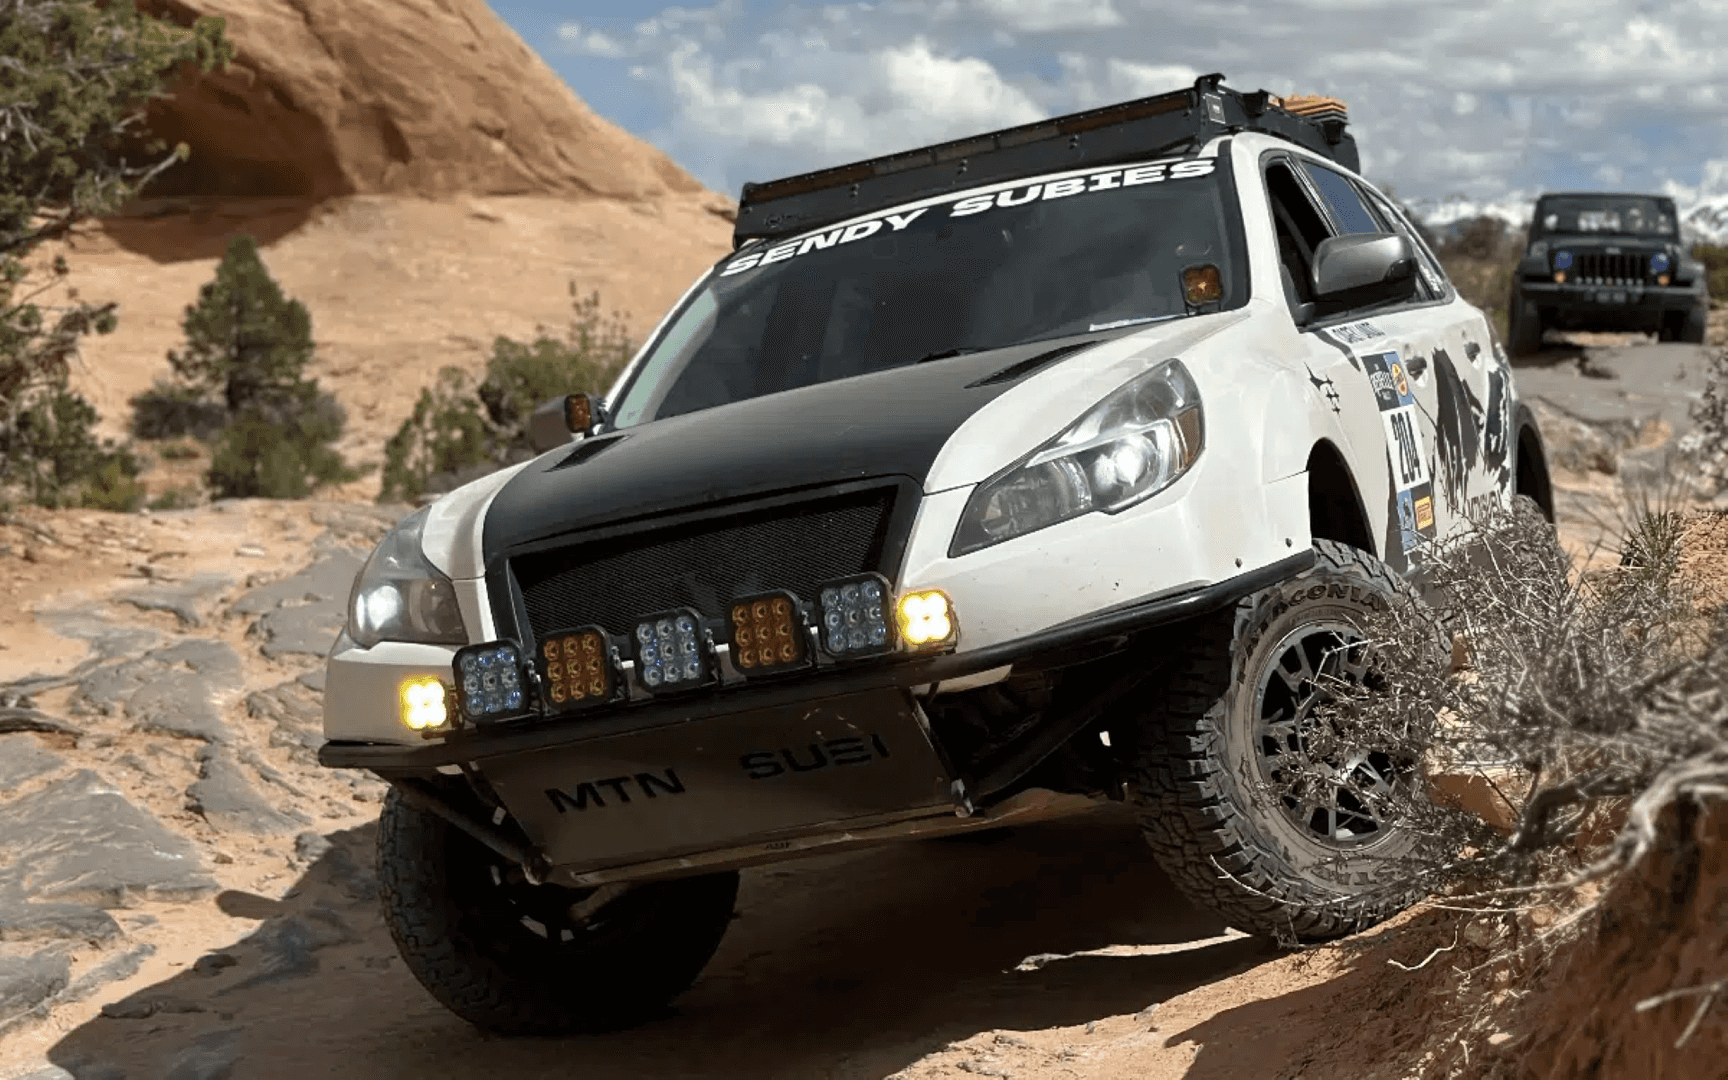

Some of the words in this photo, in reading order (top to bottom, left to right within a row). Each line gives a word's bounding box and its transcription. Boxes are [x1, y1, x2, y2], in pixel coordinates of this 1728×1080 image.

[720, 208, 929, 277] SENDY
[949, 159, 1217, 218] SUBIES
[1390, 411, 1422, 485] 204
[544, 767, 686, 814] MTN
